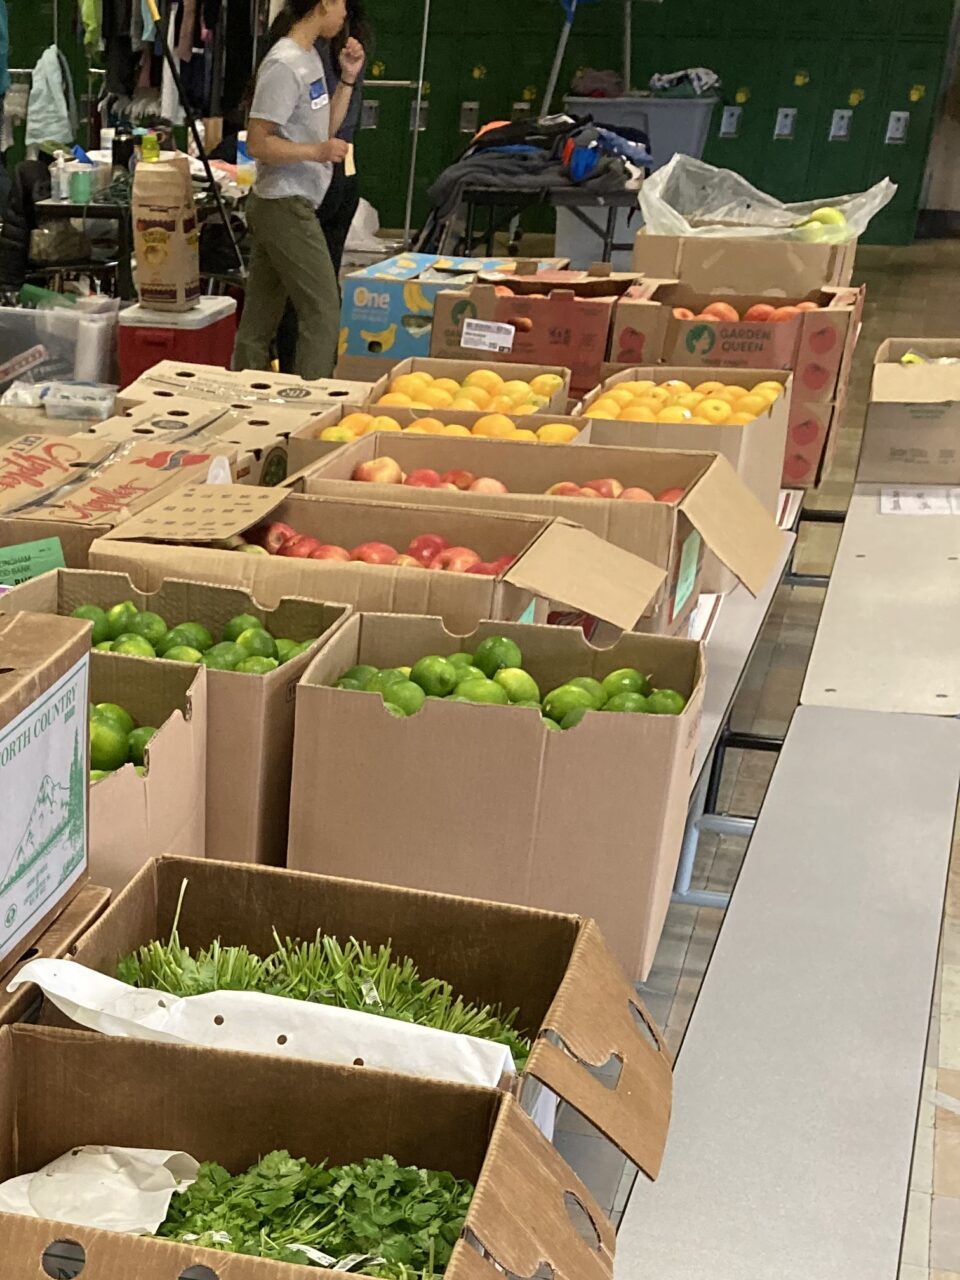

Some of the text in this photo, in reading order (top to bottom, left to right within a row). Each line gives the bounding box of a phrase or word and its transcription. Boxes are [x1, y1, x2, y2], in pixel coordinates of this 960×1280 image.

[720, 328, 771, 340] GARDEN
[721, 341, 764, 352] QUEEN
[34, 683, 78, 738] COUNTRY
